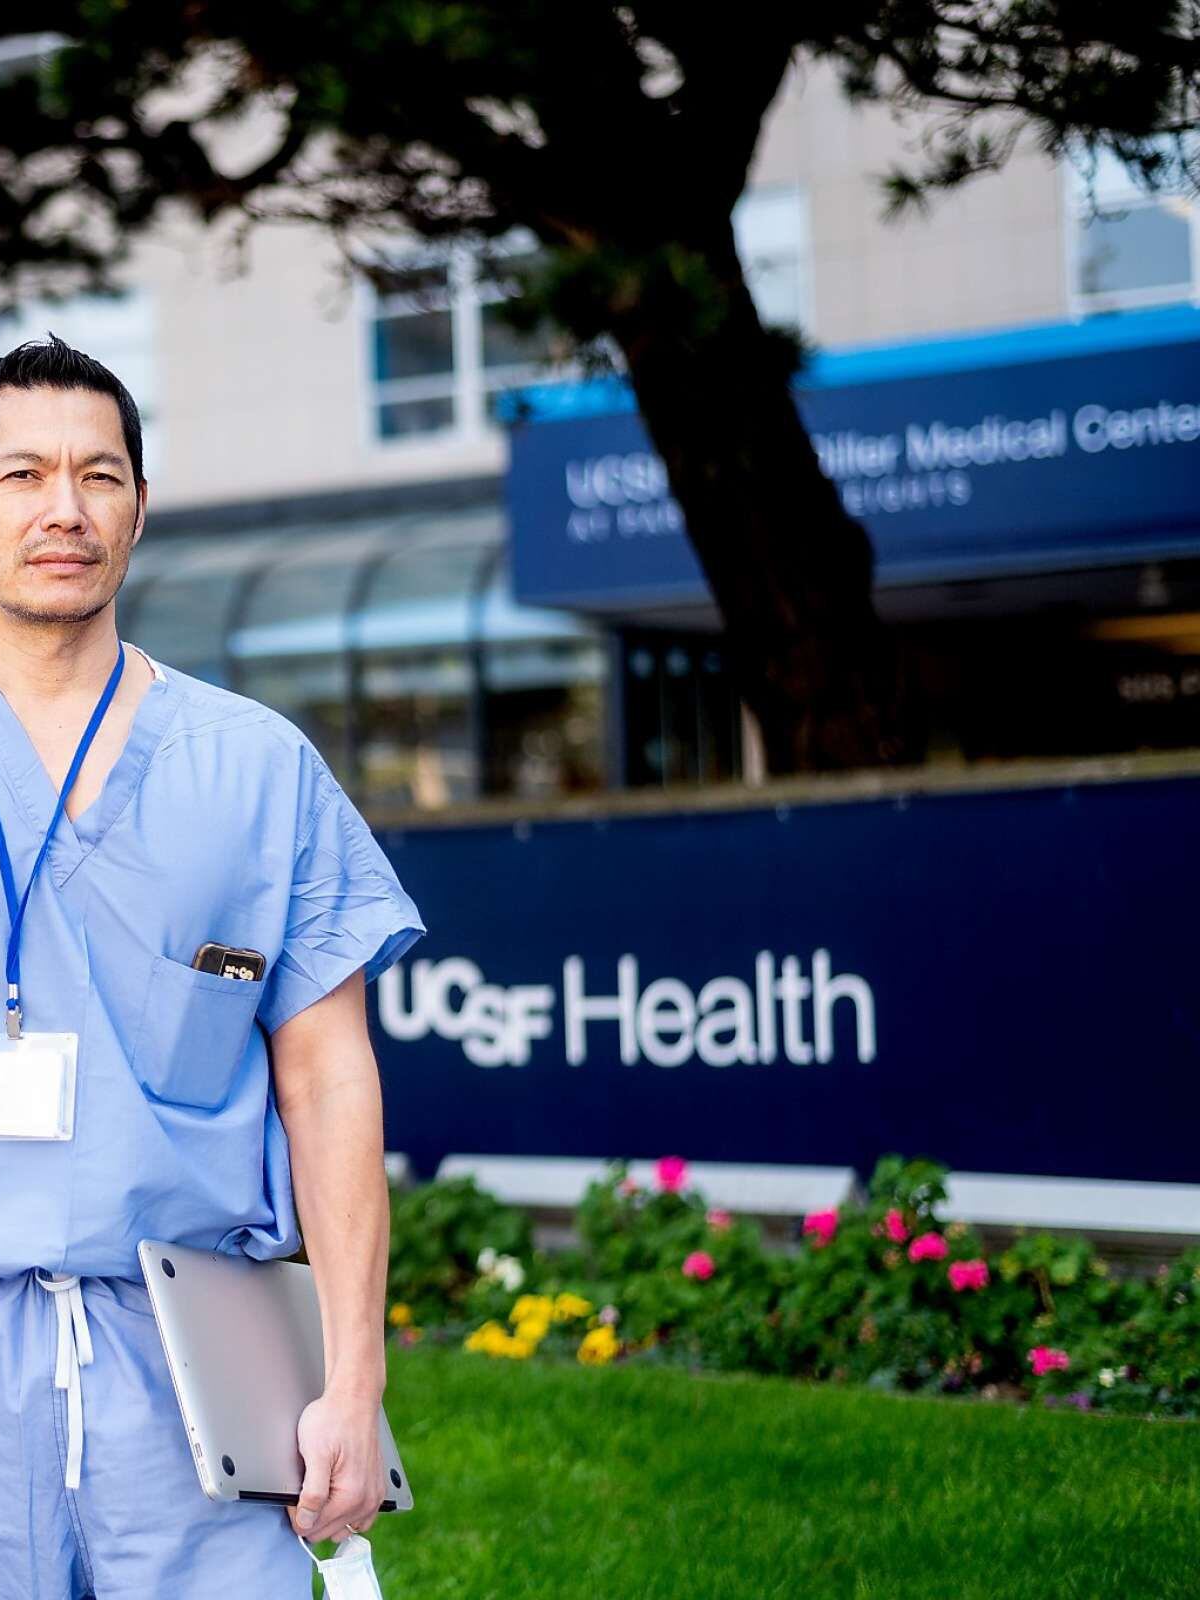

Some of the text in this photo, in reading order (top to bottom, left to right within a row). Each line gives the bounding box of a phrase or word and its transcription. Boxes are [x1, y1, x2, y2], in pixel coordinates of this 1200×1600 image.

[906, 409, 1067, 474] Medical
[1073, 401, 1200, 453] Cente
[842, 470, 973, 517] EIGHTS
[378, 947, 877, 1068] UCSF Health
